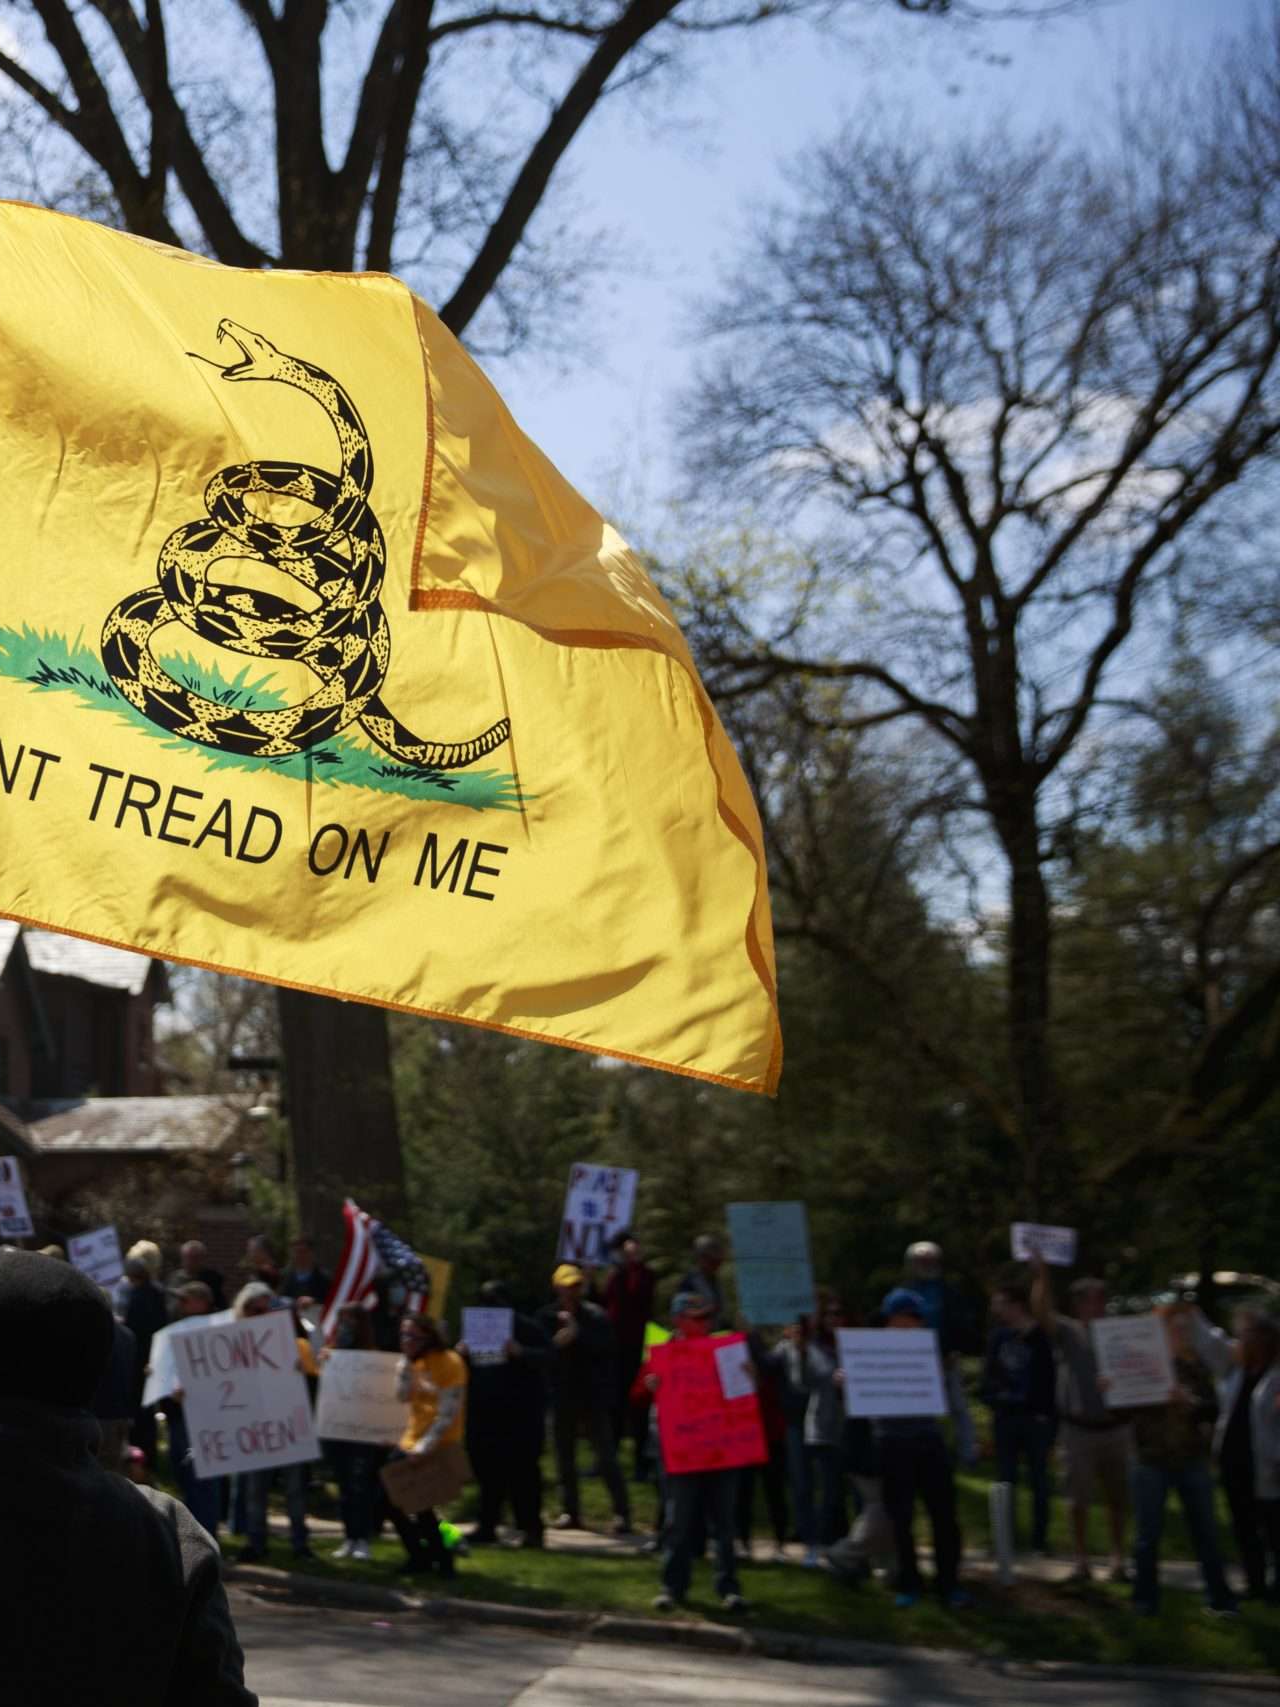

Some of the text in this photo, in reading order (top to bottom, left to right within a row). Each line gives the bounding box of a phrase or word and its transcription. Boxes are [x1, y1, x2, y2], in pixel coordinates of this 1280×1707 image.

[87, 763, 283, 865] TREAD
[308, 823, 391, 884] ON
[414, 832, 509, 902] ME
[218, 1380, 249, 1411] 2
